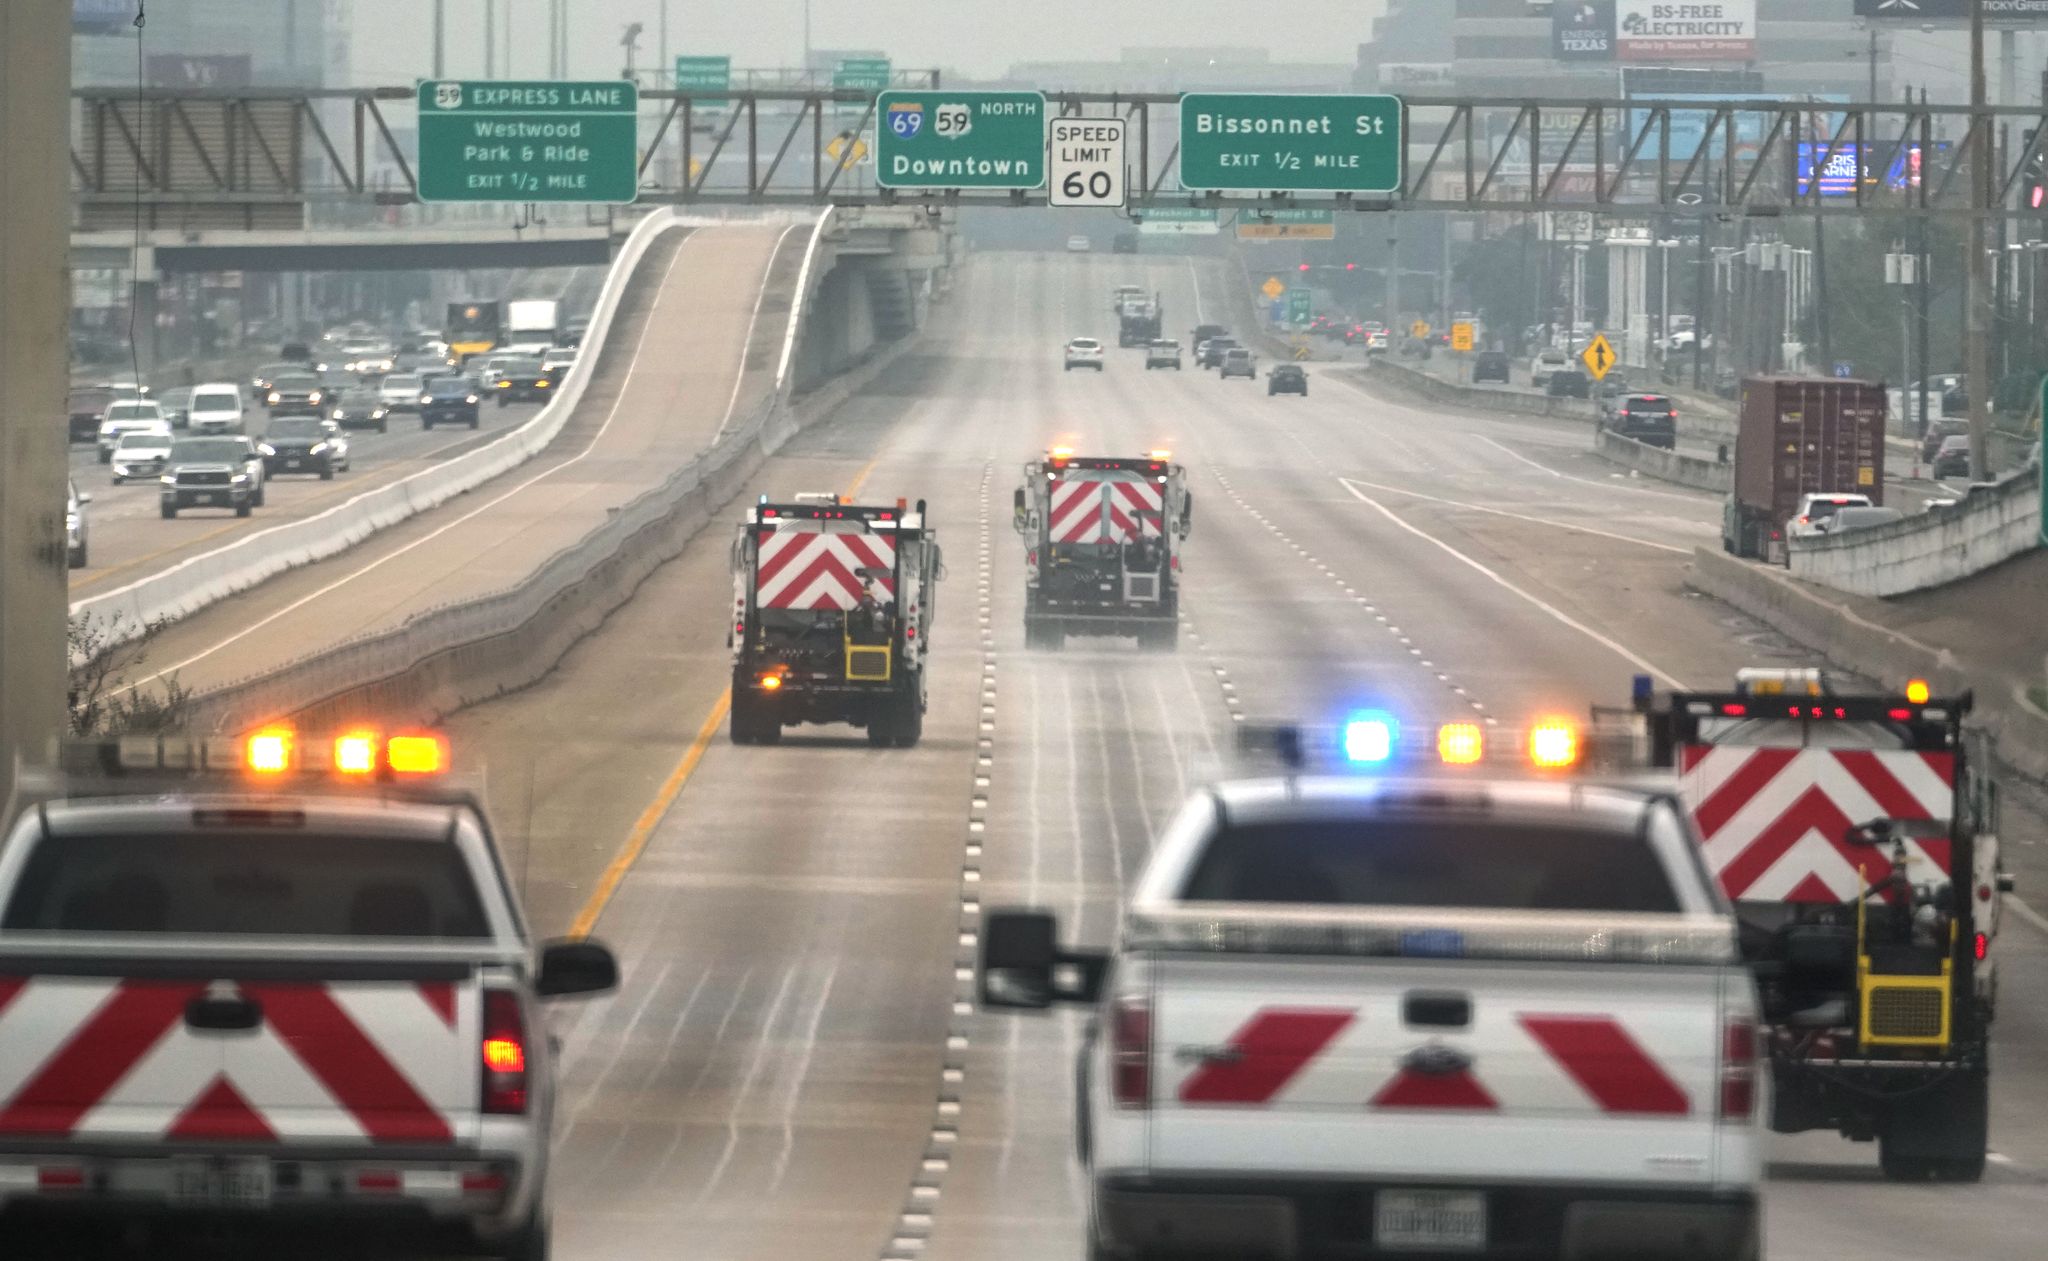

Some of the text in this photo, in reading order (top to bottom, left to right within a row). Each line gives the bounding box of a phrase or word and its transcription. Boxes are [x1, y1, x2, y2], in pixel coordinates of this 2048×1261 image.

[1653, 5, 1723, 19] BS-FREE
[1982, 0, 2048, 11] TICKYGREE
[1561, 30, 1607, 39] ENERGY
[1632, 22, 1743, 36] ELECTRICITY
[1561, 39, 1608, 51] TEXAS
[438, 88, 622, 105] 59 EXPRESS LANE
[892, 102, 1036, 133] 69 59 NORTH
[1196, 113, 1384, 135] Bissonnet St
[474, 121, 581, 138] Westwood
[1056, 127, 1120, 142] SPEED
[464, 145, 590, 162] Park & Ride
[1061, 148, 1112, 163] LIMIT
[1220, 154, 1260, 167] EXIT
[1315, 155, 1360, 168] MILE
[893, 155, 1029, 175] Downtown
[467, 175, 504, 188] EXIT
[549, 175, 587, 188] MILE
[1062, 171, 1112, 198] 60
